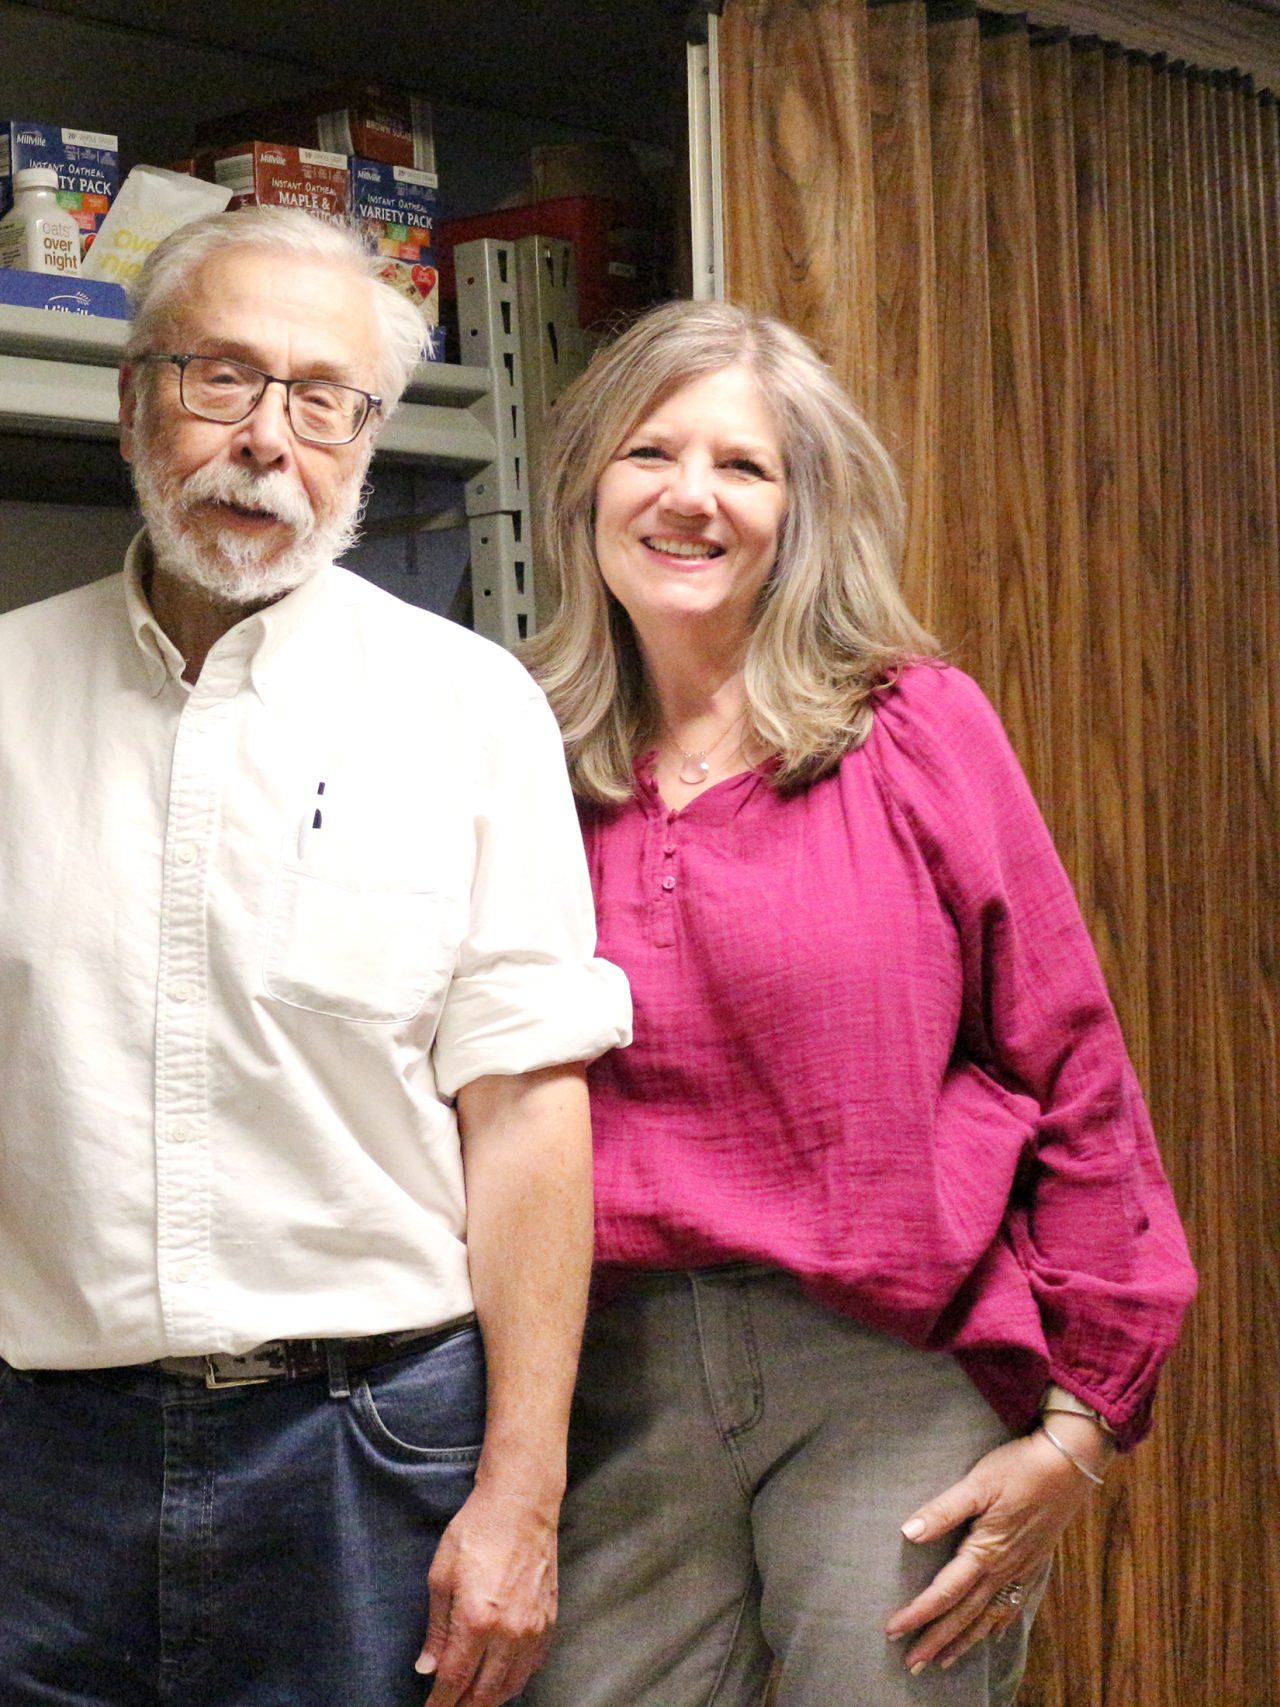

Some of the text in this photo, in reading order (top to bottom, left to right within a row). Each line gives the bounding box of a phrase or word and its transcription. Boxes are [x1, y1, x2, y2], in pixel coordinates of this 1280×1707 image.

[17, 132, 46, 147] Millville
[260, 152, 286, 166] Millville
[29, 158, 105, 179] INSTANT OATMEAL
[357, 170, 381, 182] Millville
[80, 177, 112, 195] PACK
[272, 178, 336, 196] INSTANT OATMEAL
[279, 191, 330, 211] MAPLE &
[368, 194, 427, 214] INSTANT OATMEAL
[359, 204, 433, 229] VARIETY PACK
[42, 222, 70, 238] oats
[43, 237, 73, 252] over
[45, 252, 78, 272] night
